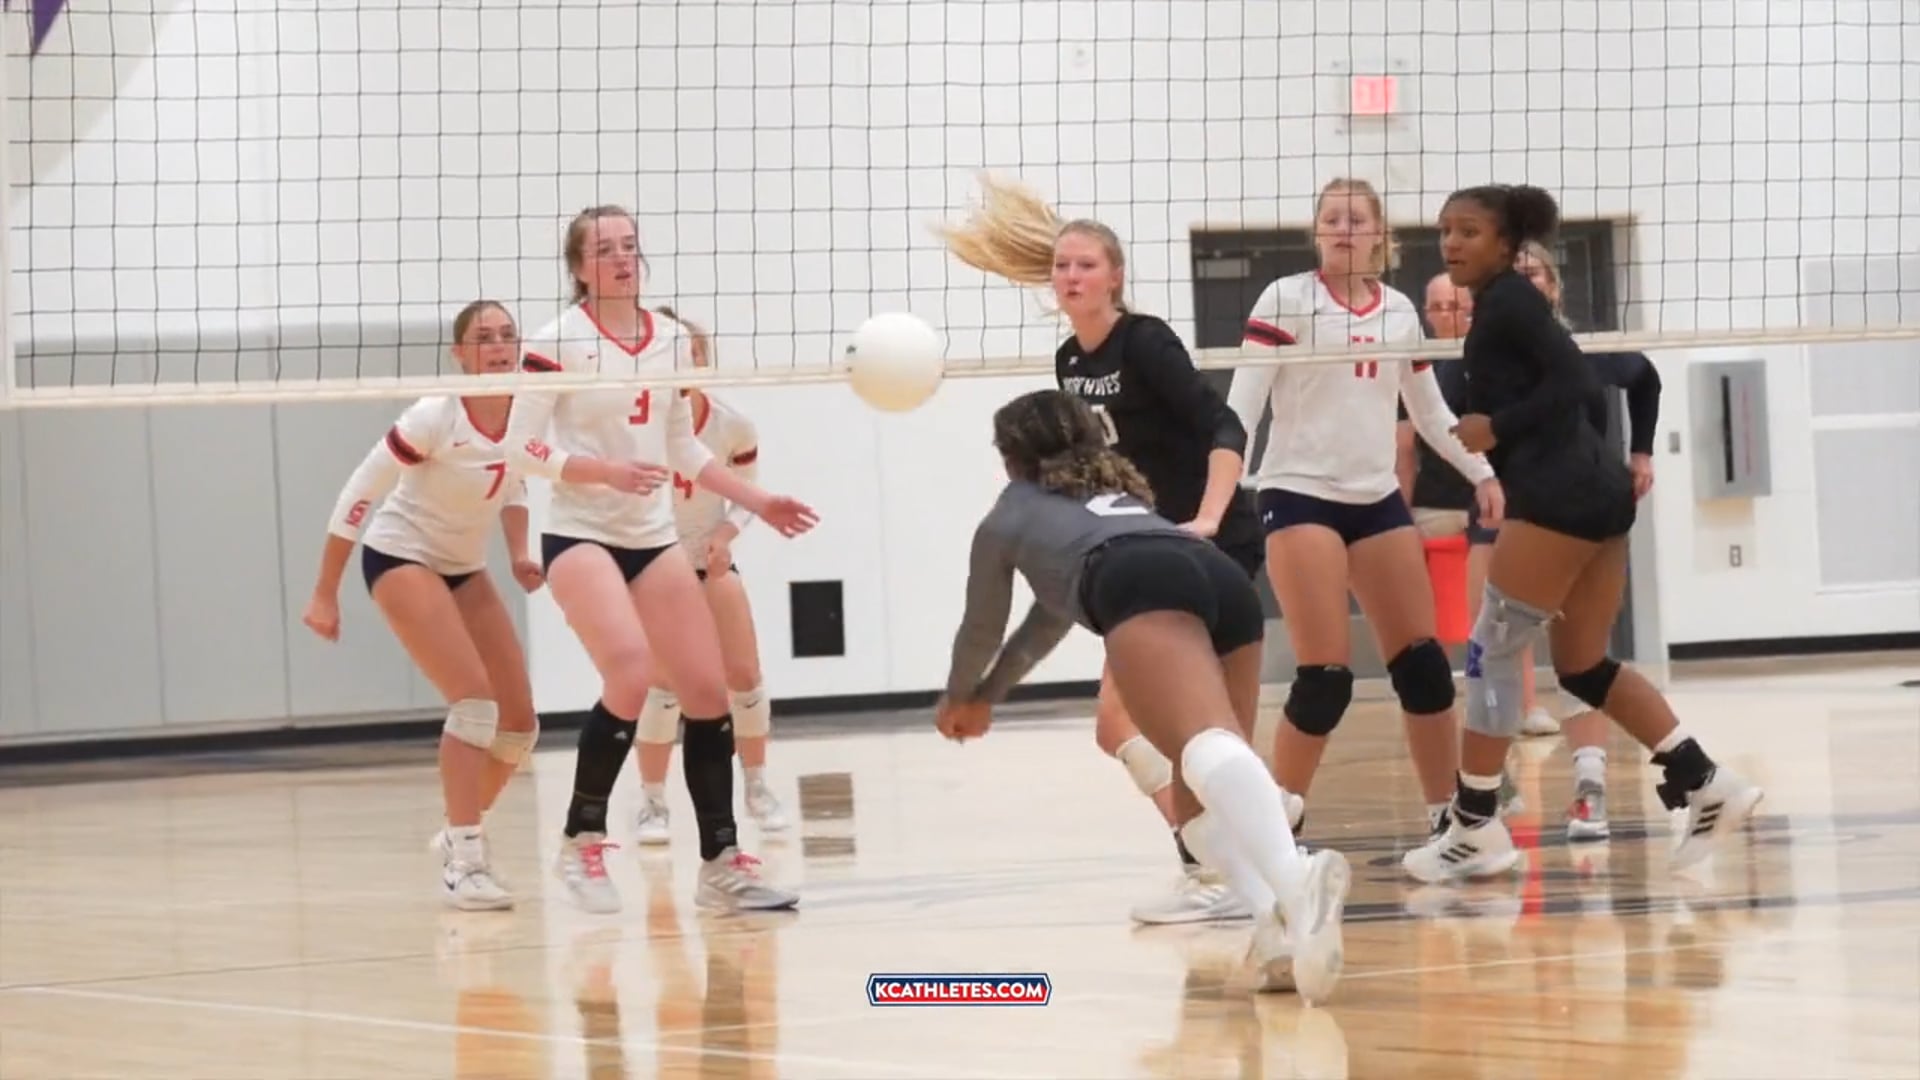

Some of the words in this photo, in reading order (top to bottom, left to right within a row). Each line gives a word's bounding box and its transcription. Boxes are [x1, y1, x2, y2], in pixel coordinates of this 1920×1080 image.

[1350, 334, 1378, 378] 11
[628, 387, 650, 425] 3
[484, 461, 506, 500] 7
[673, 471, 693, 499] 4
